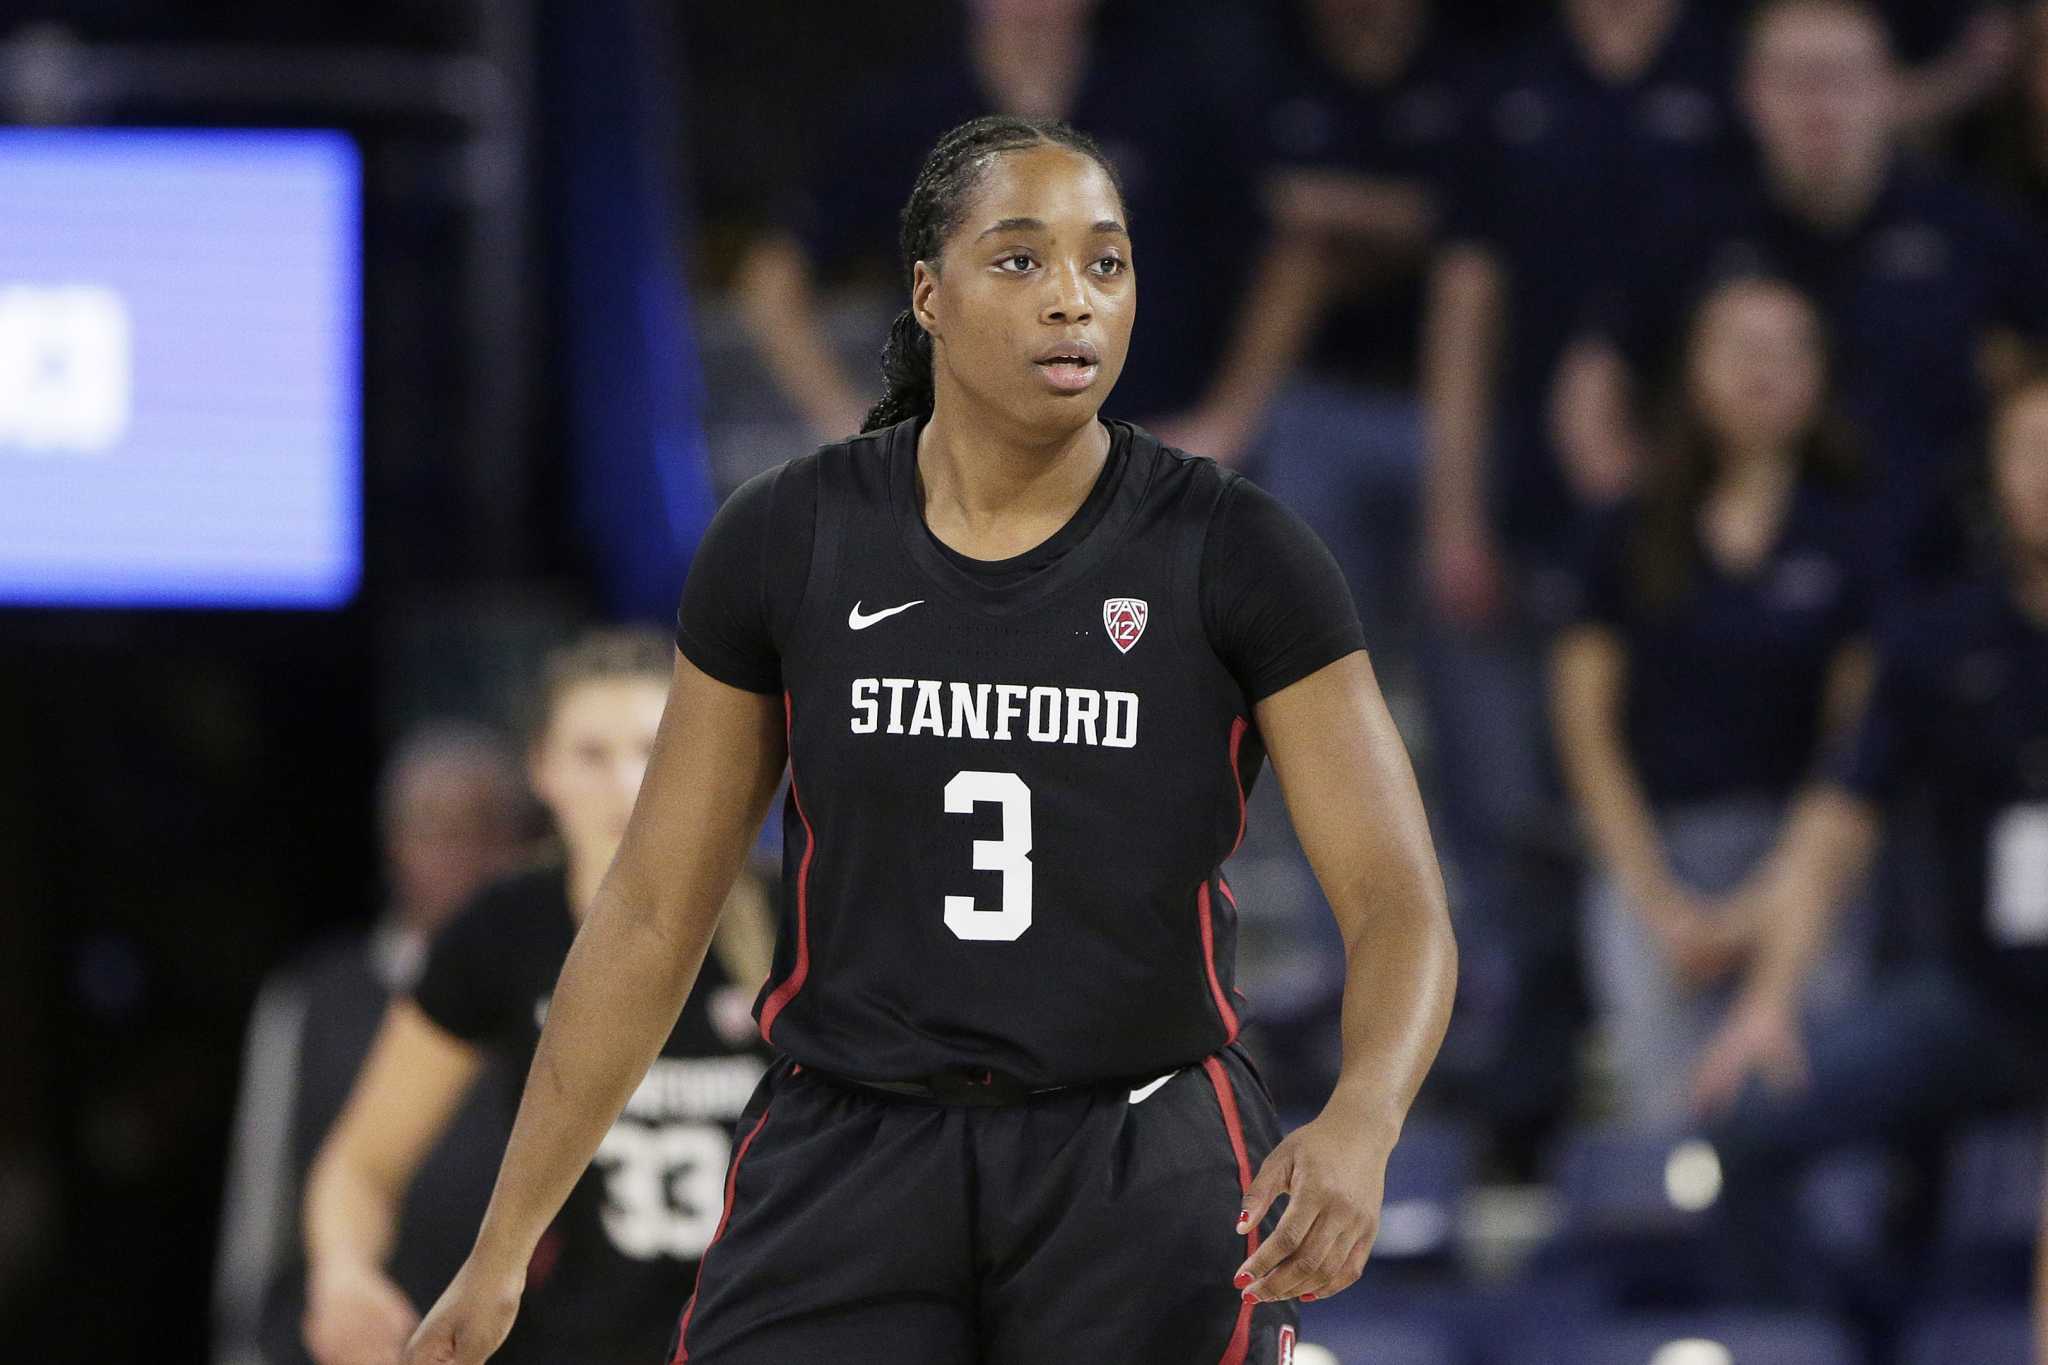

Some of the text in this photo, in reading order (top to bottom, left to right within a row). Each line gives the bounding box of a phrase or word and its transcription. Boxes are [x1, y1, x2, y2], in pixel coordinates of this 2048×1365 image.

[1107, 600, 1145, 630] PAC
[1114, 620, 1136, 640] 12
[850, 677, 1139, 748] STANFORD
[944, 770, 1033, 941] 3
[595, 1119, 734, 1261] 33
